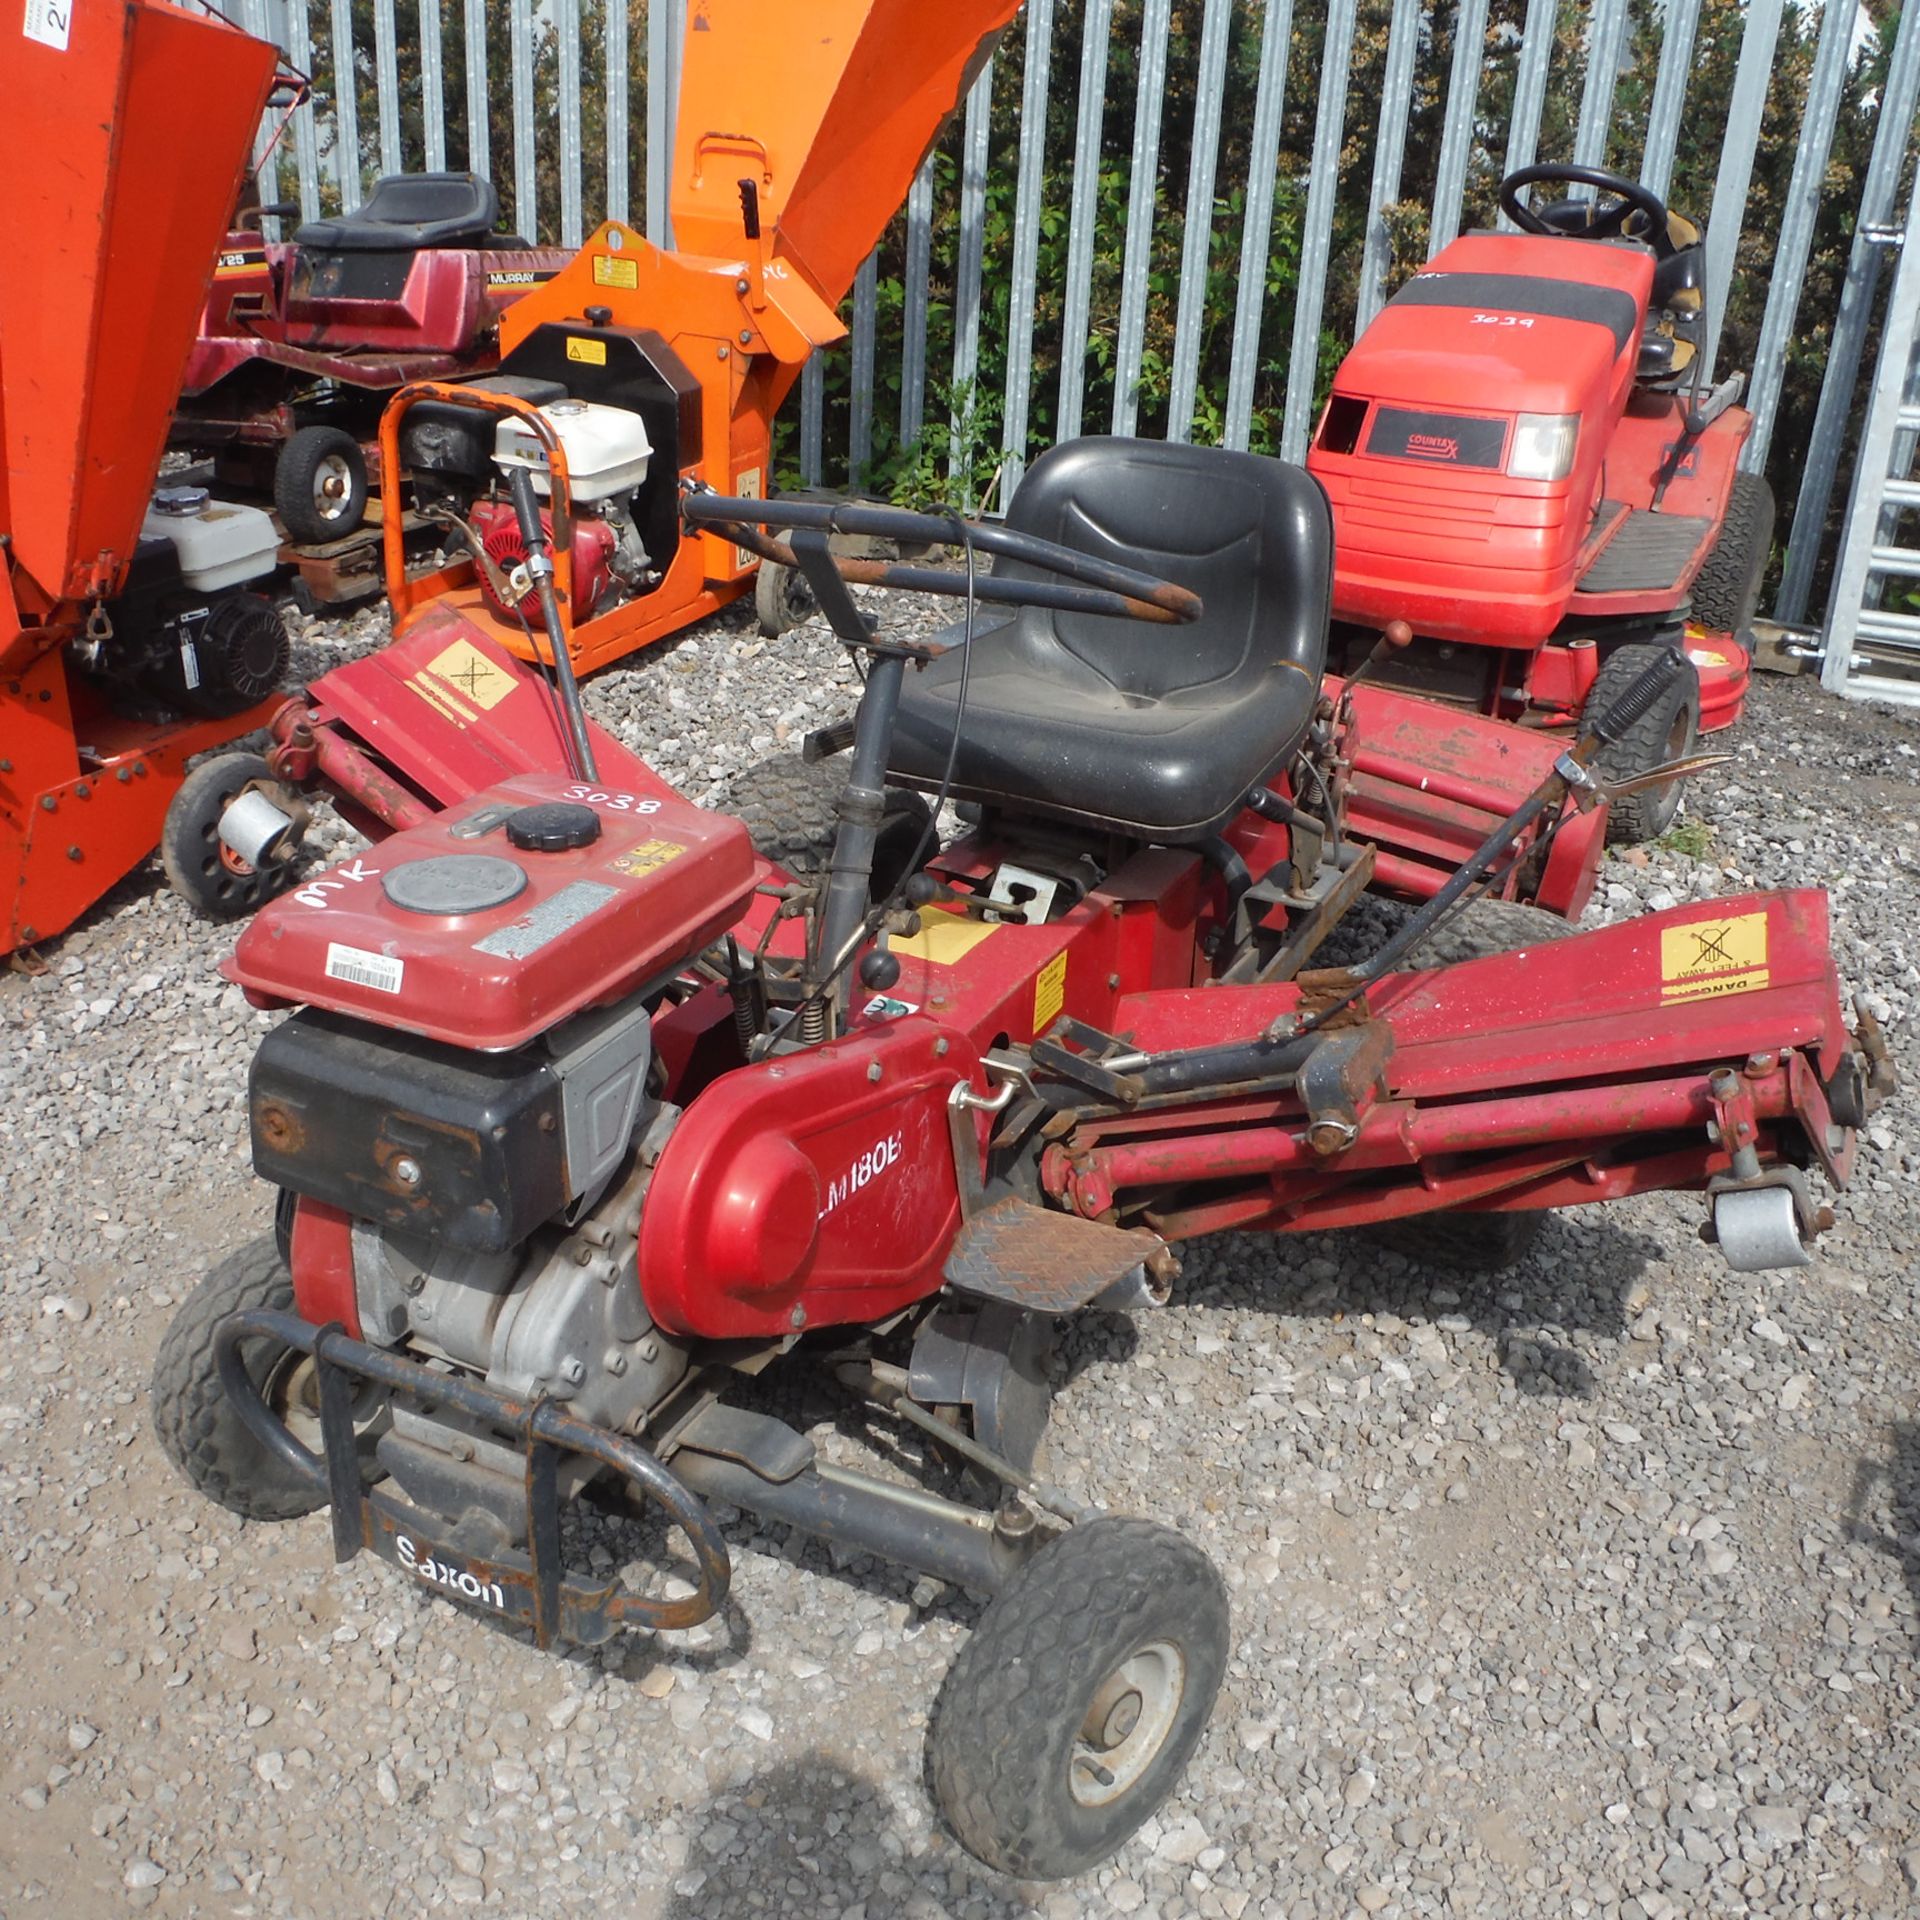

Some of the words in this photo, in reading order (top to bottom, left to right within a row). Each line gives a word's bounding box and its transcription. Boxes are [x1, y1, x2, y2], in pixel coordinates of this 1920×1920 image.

[490, 271, 535, 284] MURRAY
[1470, 314, 1535, 328] 3039
[563, 785, 661, 814] 3038
[396, 1535, 504, 1609] Saxon
